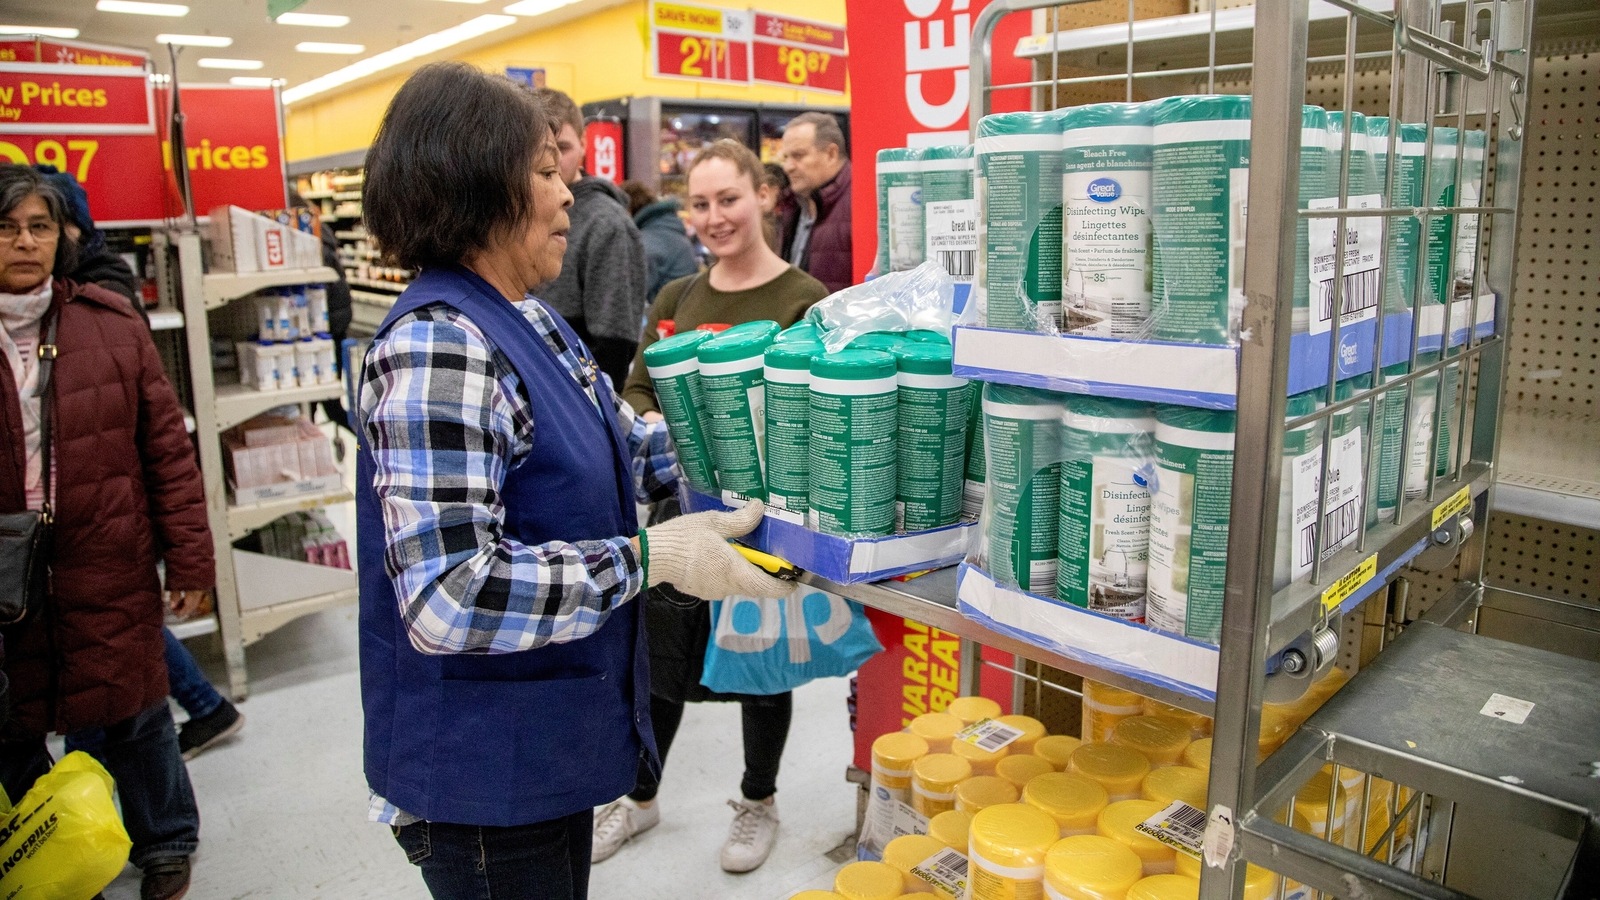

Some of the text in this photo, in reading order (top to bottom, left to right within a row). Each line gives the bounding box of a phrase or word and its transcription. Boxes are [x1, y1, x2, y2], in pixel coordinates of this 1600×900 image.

[21, 81, 108, 107] Prices
[1084, 149, 1127, 158] Bleach Free
[1077, 161, 1095, 170] agent
[1095, 160, 1106, 168] de
[1090, 183, 1115, 193] Great
[1066, 206, 1146, 217] Disinfecting Wipe
[952, 220, 966, 232] Great
[1082, 221, 1127, 231] Lingettes
[1073, 231, 1139, 241] désinfectantes
[1094, 273, 1105, 282] 35
[1341, 342, 1357, 358] Great
